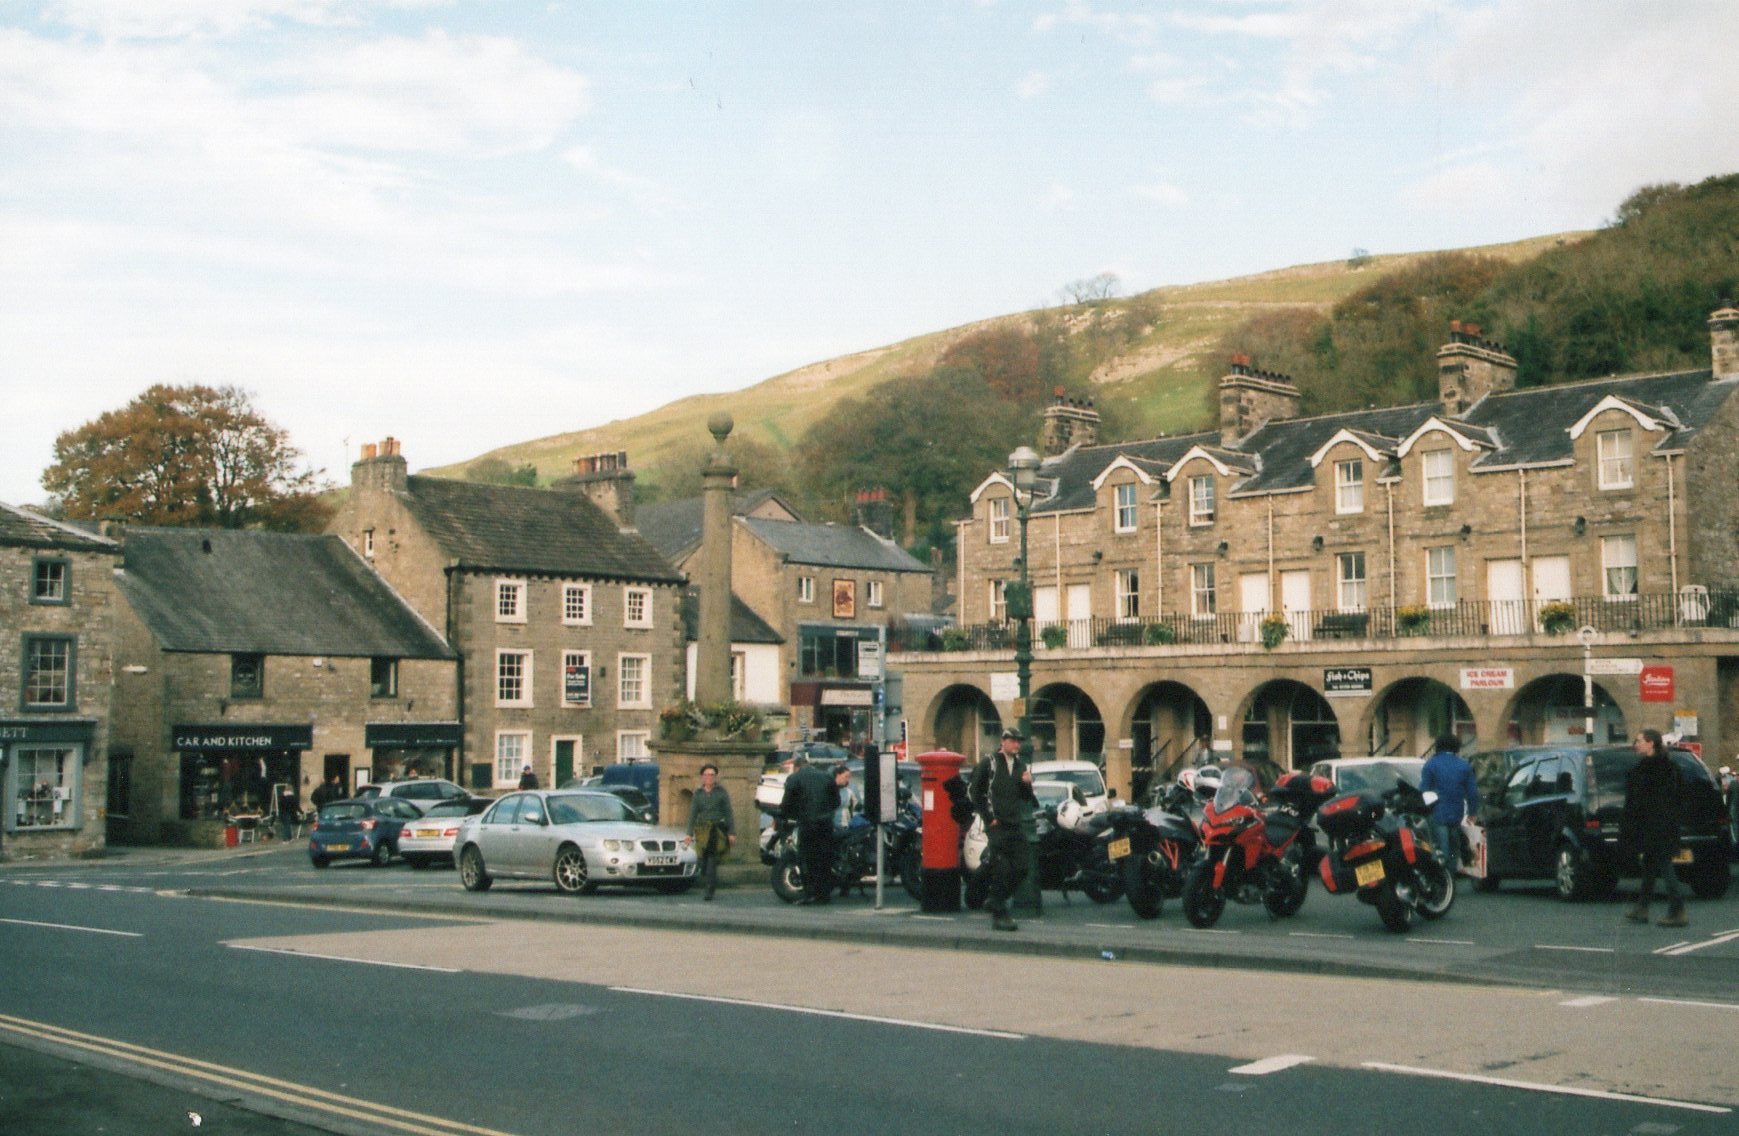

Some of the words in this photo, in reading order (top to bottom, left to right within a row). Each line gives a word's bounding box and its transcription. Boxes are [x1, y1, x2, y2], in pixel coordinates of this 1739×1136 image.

[1347, 670, 1370, 682] Chips
[0, 727, 27, 738] ETT
[177, 736, 200, 747] CAR
[202, 736, 225, 747] AND
[228, 736, 272, 746] KITCHEN
